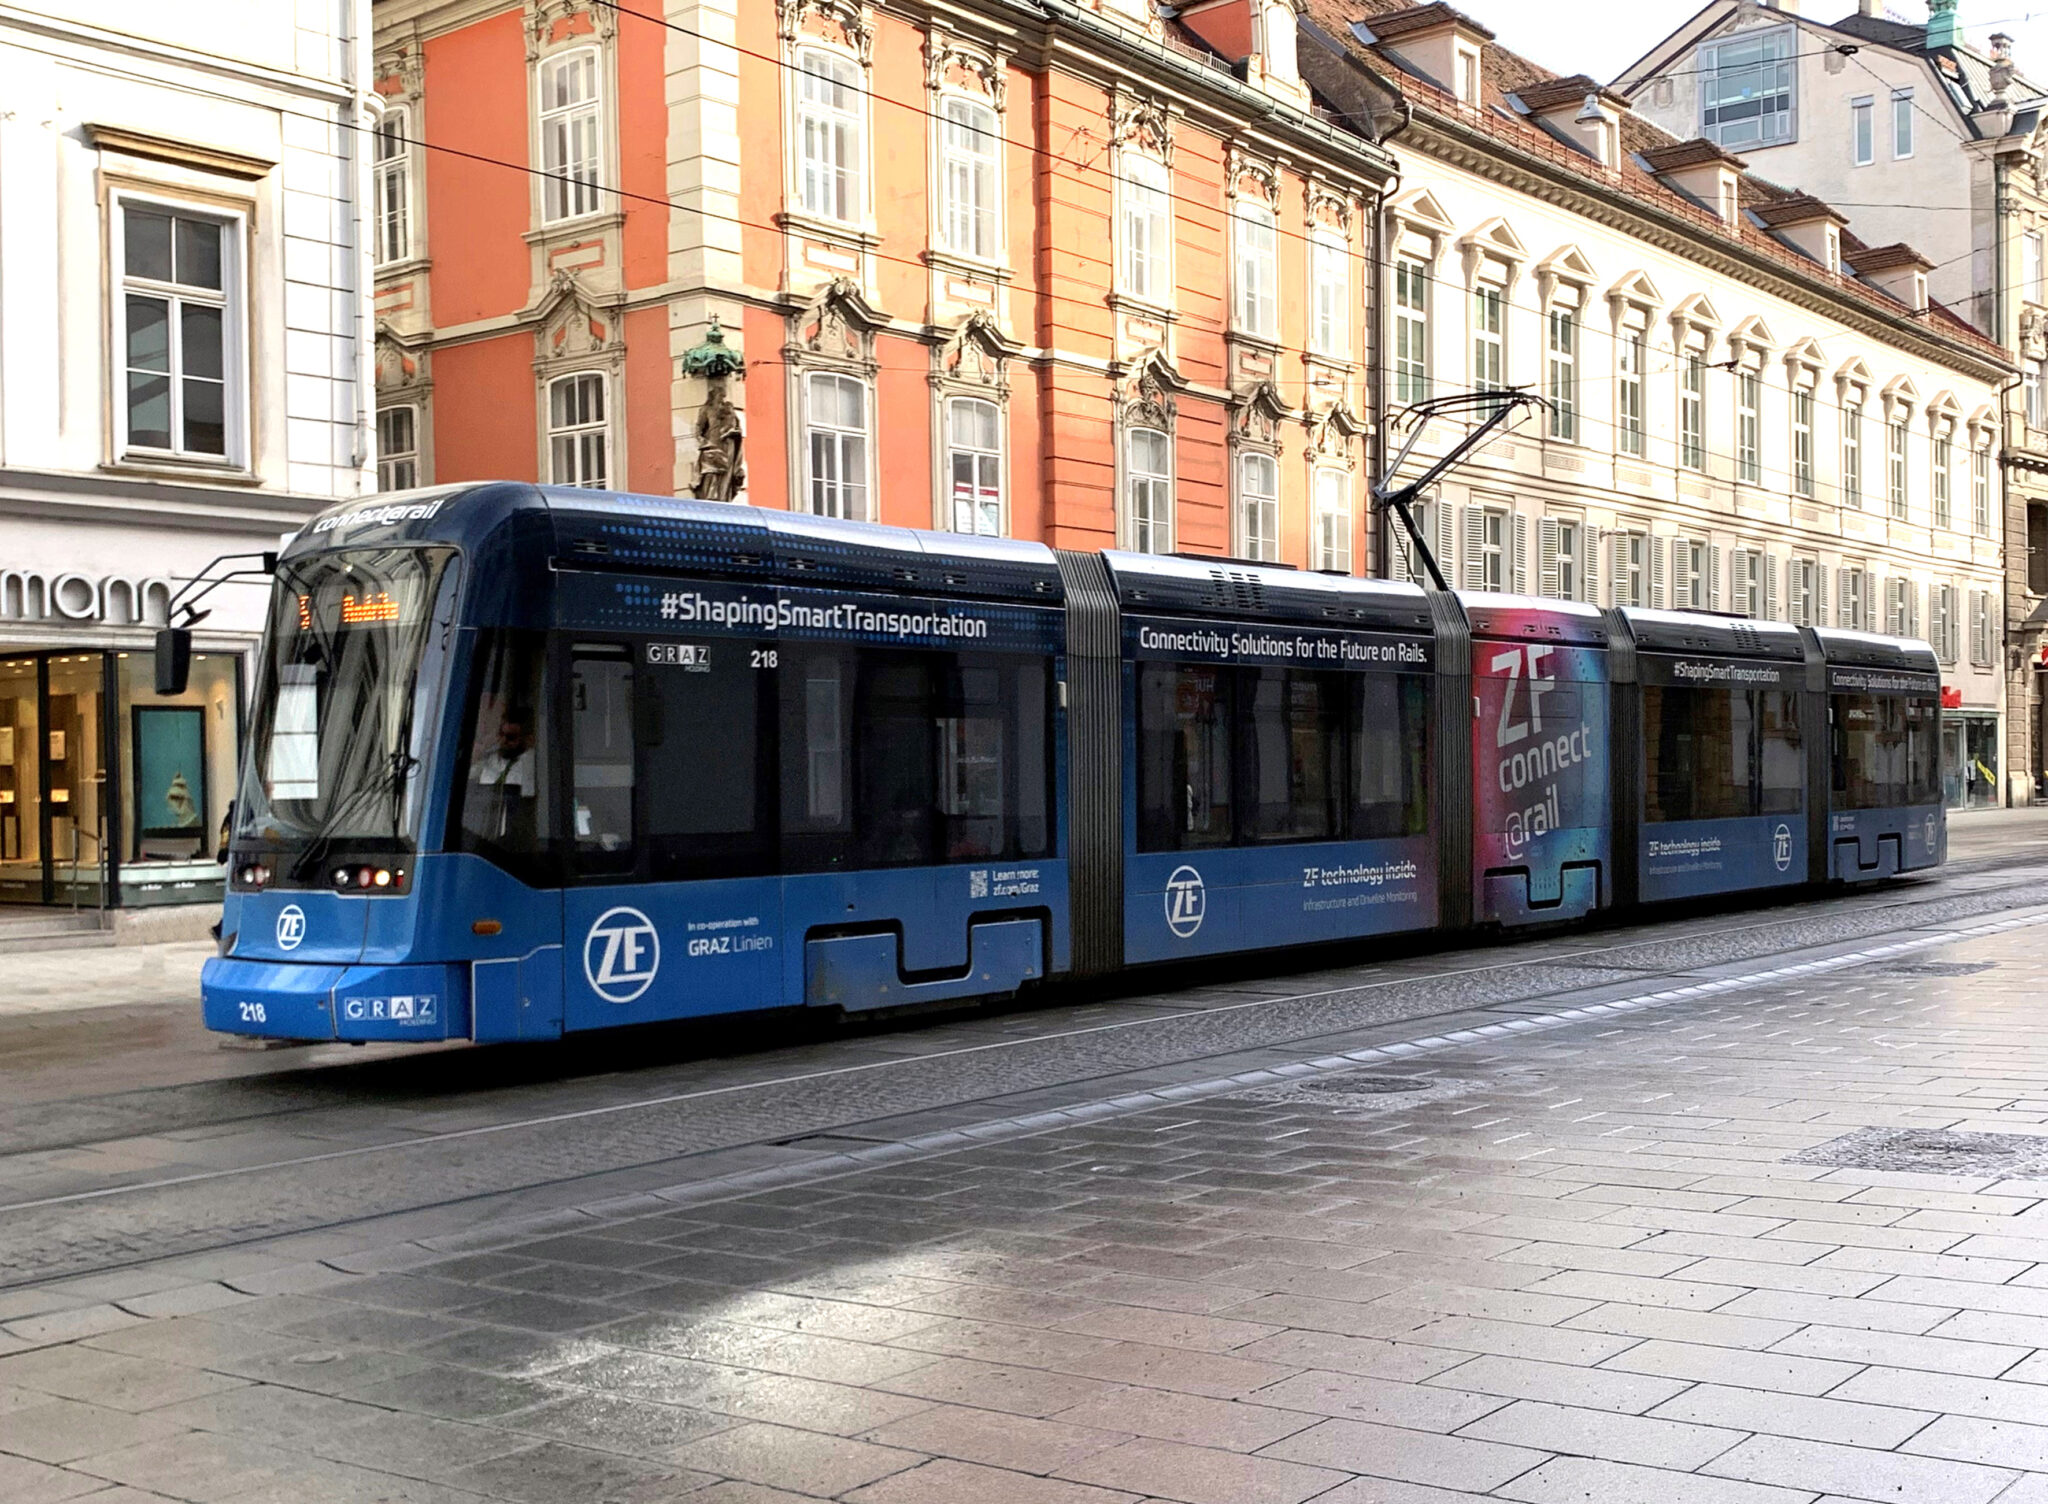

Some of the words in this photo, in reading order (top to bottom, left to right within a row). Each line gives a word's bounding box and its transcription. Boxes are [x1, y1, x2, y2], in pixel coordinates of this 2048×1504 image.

[661, 592, 987, 638] #ShapingSmartTransportation
[648, 645, 708, 665] GRAZ
[1140, 626, 1229, 658] Connectivity
[1232, 633, 1294, 657] Solutions
[1296, 637, 1315, 658] for
[1317, 639, 1338, 659] the
[1340, 640, 1378, 661] Future
[1381, 647, 1396, 662] on
[1399, 643, 1428, 663] Rails.
[750, 650, 778, 669] 218
[1674, 661, 1780, 684] #ShapingSmartTransportation
[1491, 644, 1555, 748] ZF
[1499, 721, 1592, 793] connect
[1505, 784, 1560, 860] @rail
[1303, 868, 1319, 887] ZF
[1321, 864, 1383, 886] technology
[1385, 860, 1417, 880] inside
[1167, 879, 1204, 924] ZF
[279, 913, 305, 942] ZF
[588, 925, 656, 986] ZF
[688, 936, 730, 956] GRAZ
[734, 935, 773, 953] Linien
[239, 1001, 267, 1023] 218
[346, 997, 433, 1019] GRAZ
